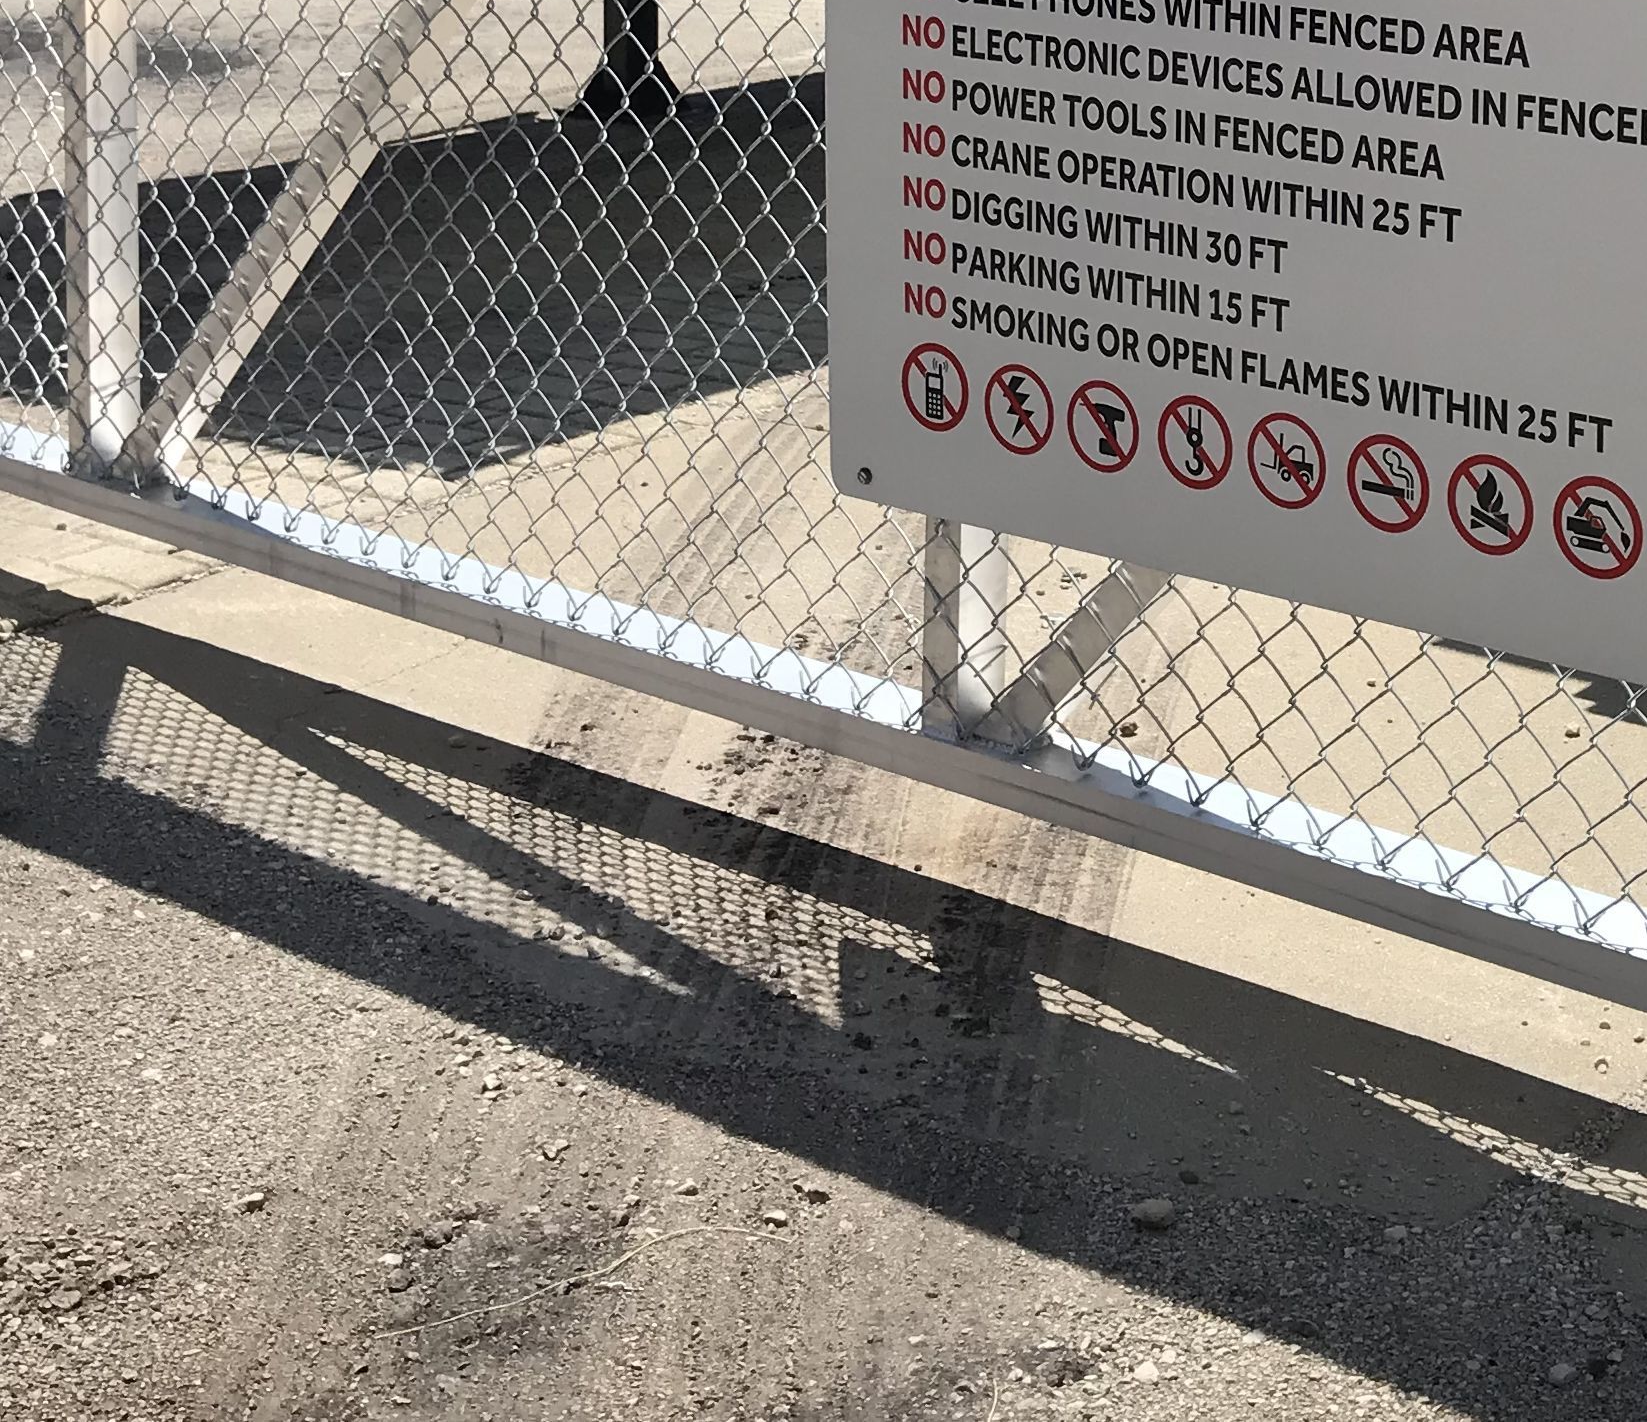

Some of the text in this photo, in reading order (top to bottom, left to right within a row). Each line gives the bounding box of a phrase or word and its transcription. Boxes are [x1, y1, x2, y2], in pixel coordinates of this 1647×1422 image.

[902, 13, 946, 50] NO
[951, 24, 1141, 80] ELECTRONIC
[1147, 47, 1284, 99] DEVICES
[1290, 66, 1463, 121] ALLOWED
[1471, 88, 1507, 128] IN
[1289, 6, 1426, 55] FENCED
[1432, 23, 1531, 69] AREA
[902, 67, 1445, 181] NO POWER TOOLS IN FENCED AREA
[902, 121, 1463, 243] NO CRANE OPERATION WITHIN 25 FT
[903, 174, 1289, 275] NO DIGGING WITHIN 30 FT
[903, 228, 1291, 333] NO PARKING WITHIN 15 FT
[903, 281, 1613, 454] NO SMOKING OR OPEN FLAMES WITHIN 25 FT
